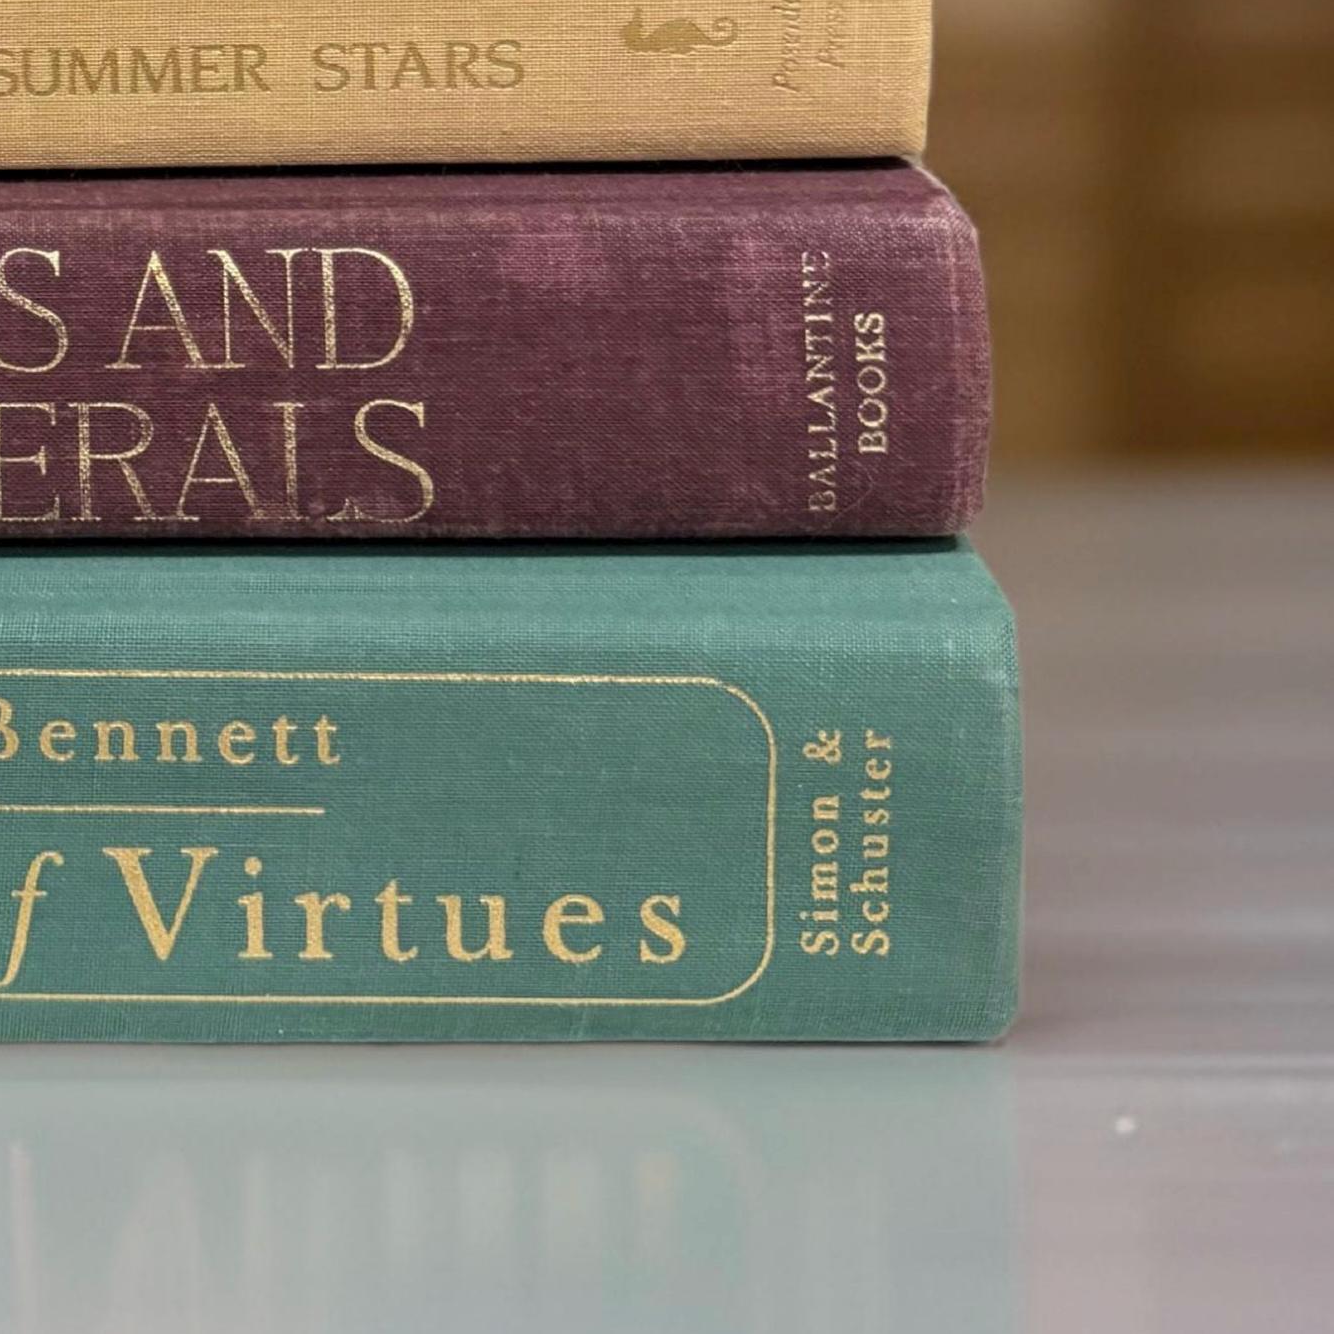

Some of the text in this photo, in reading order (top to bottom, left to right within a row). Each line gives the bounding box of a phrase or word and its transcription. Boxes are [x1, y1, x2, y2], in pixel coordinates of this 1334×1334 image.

[313, 40, 525, 93] STARS
[105, 247, 415, 371] AND
[853, 312, 888, 455] BOOKS
[102, 846, 689, 964] Virtues
[799, 729, 842, 957] Simon &
[850, 728, 893, 957] Schuster
